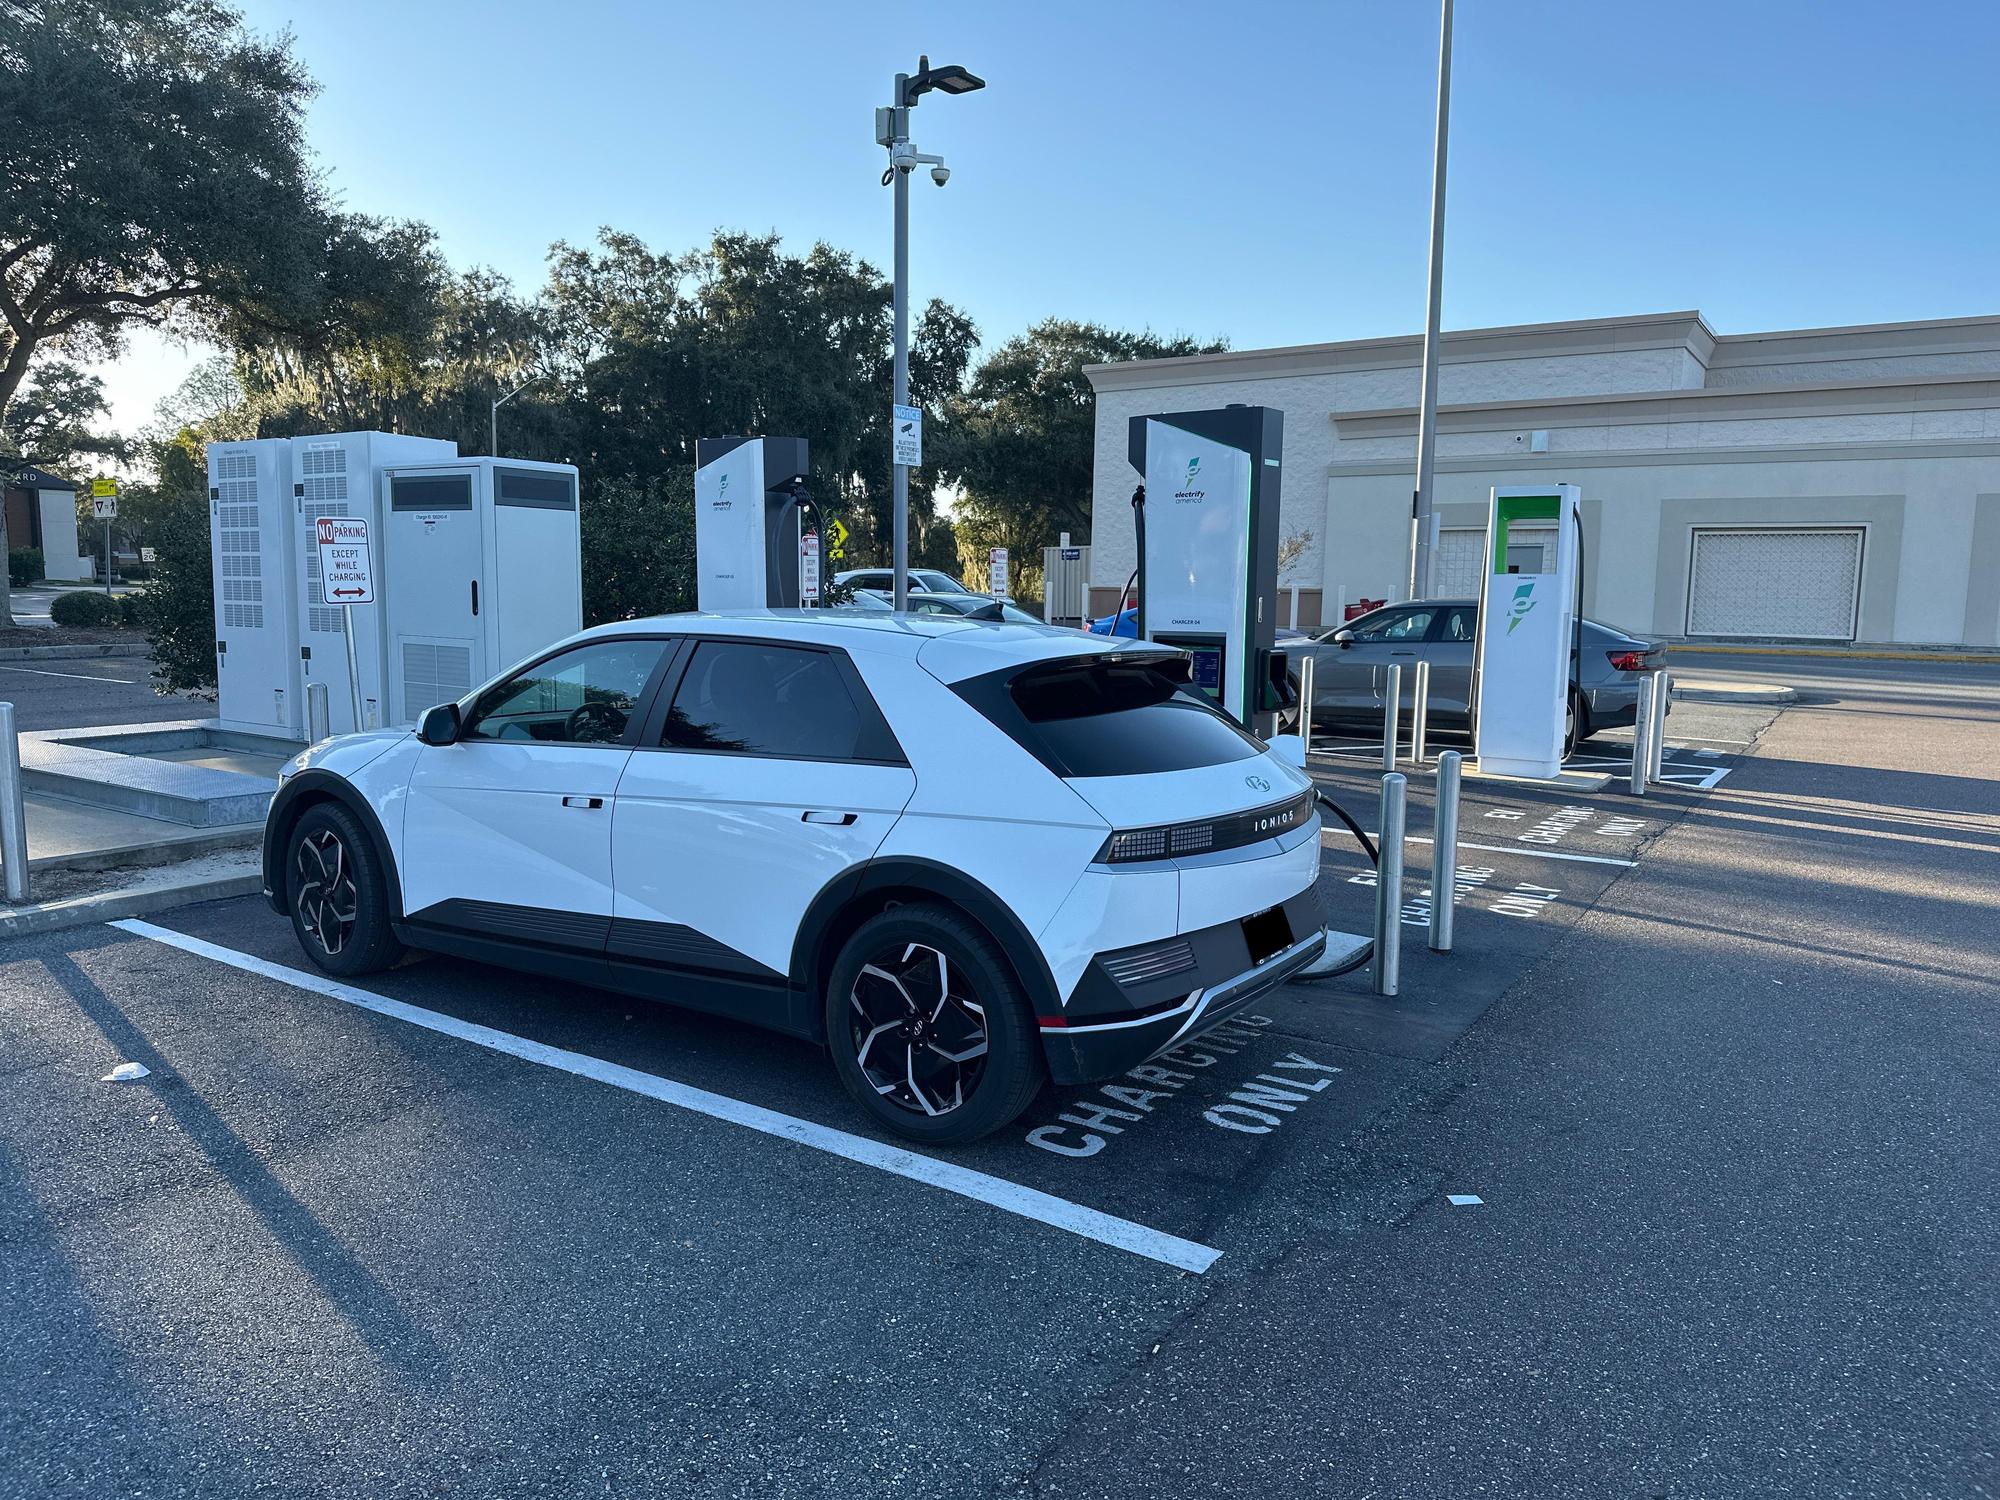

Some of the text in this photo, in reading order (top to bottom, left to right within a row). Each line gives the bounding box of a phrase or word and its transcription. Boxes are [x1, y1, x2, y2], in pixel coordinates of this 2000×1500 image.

[895, 407, 920, 420] NOTICE
[1175, 491, 1205, 499] electrify
[318, 523, 366, 540] NO PARKING
[331, 549, 358, 558] EXCEPT
[335, 561, 358, 570] WHILE
[328, 573, 366, 581] CHARGING
[1483, 808, 1526, 820] EV
[1518, 805, 1596, 844] CHARGING
[1594, 816, 1647, 836] ONLY
[1487, 882, 1562, 917] ONLY
[1025, 1013, 1273, 1158] CHARGING
[1203, 1052, 1343, 1134] ONLY
